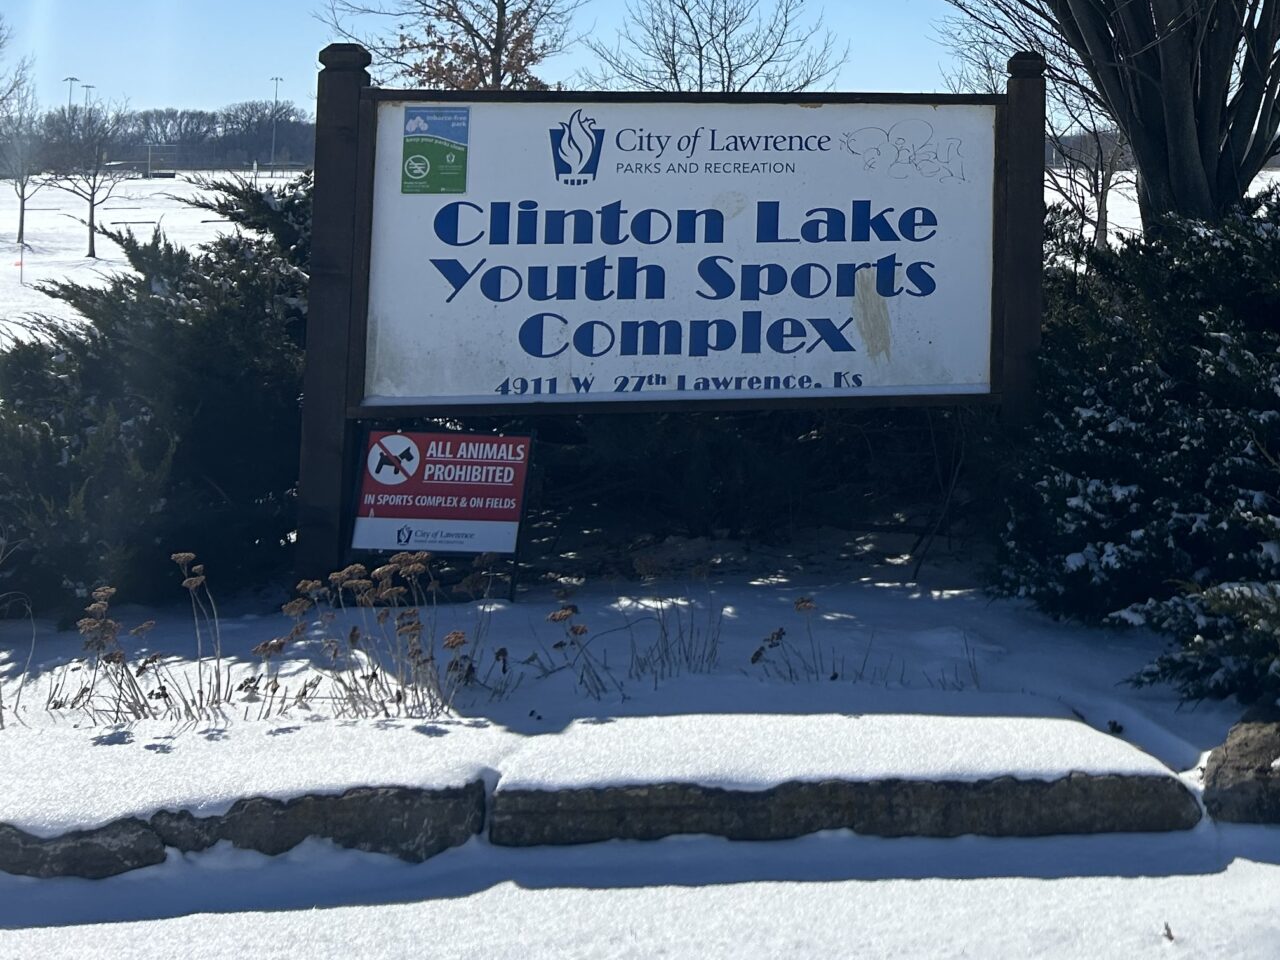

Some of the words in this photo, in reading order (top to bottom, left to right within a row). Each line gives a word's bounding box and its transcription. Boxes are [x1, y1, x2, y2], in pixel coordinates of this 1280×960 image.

[615, 128, 672, 158] City
[677, 127, 705, 158] of
[709, 129, 831, 152] Lawrence
[616, 162, 661, 173] PARKS
[666, 162, 699, 173] AND
[704, 162, 796, 173] RECREATION
[433, 199, 724, 247] Clinton
[756, 200, 938, 243] Lake
[428, 255, 666, 303] Youth
[696, 253, 937, 301] Sports
[518, 310, 857, 359] Complex
[494, 376, 558, 395] 4911
[570, 376, 595, 394] W
[614, 373, 667, 393] 27th
[833, 371, 863, 388] Ks
[426, 440, 453, 458] ALL
[457, 442, 525, 461] ANIMALS
[423, 464, 515, 483] PROHIBITED
[364, 494, 376, 505] IN
[376, 494, 413, 506] SPORTS
[415, 495, 458, 508] COMPLEX
[459, 496, 468, 508] &
[469, 497, 484, 508] ON
[485, 497, 516, 509] FIELDS
